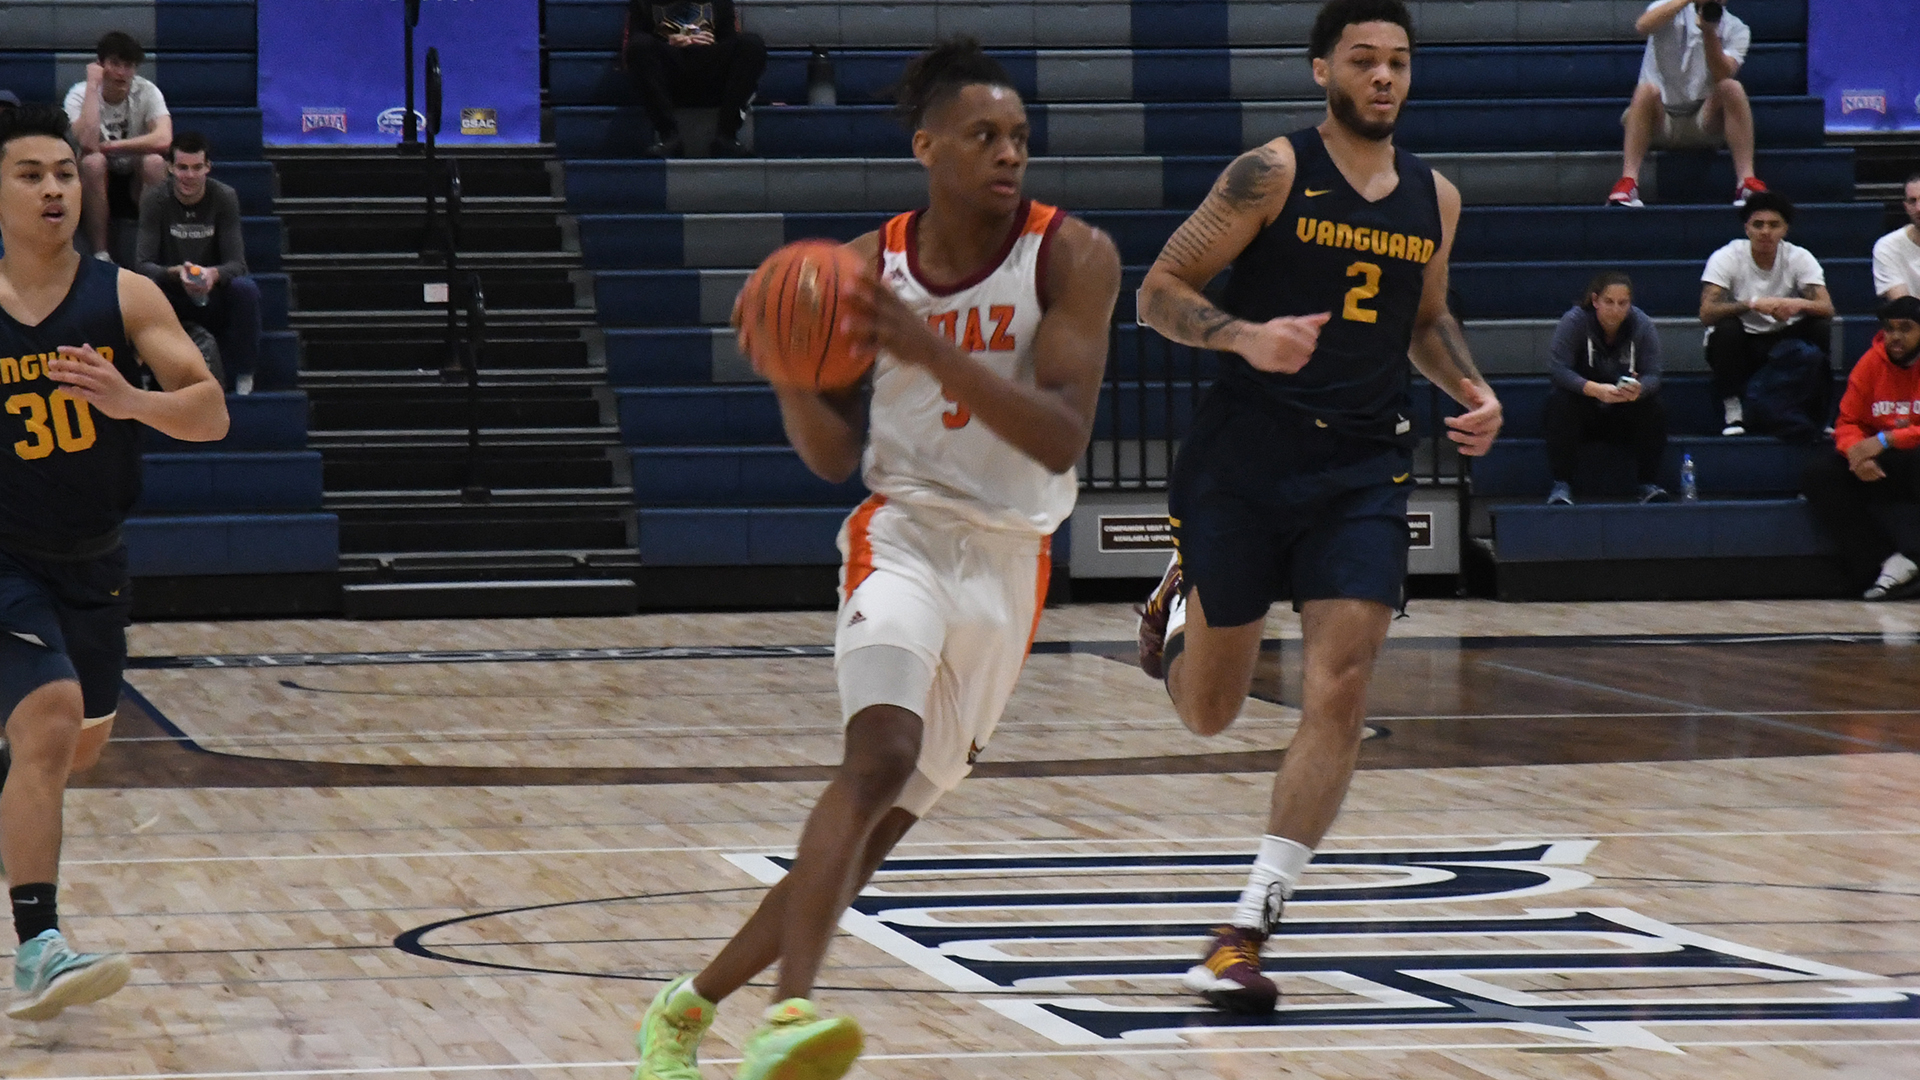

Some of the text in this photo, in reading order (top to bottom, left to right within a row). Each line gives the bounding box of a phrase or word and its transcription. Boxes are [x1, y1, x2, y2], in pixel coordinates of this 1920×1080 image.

[304, 115, 345, 130] NAIA
[462, 119, 496, 129] GSAC
[1296, 217, 1435, 264] VANGUARD
[1342, 261, 1383, 324] 2
[4, 387, 97, 460] 30
